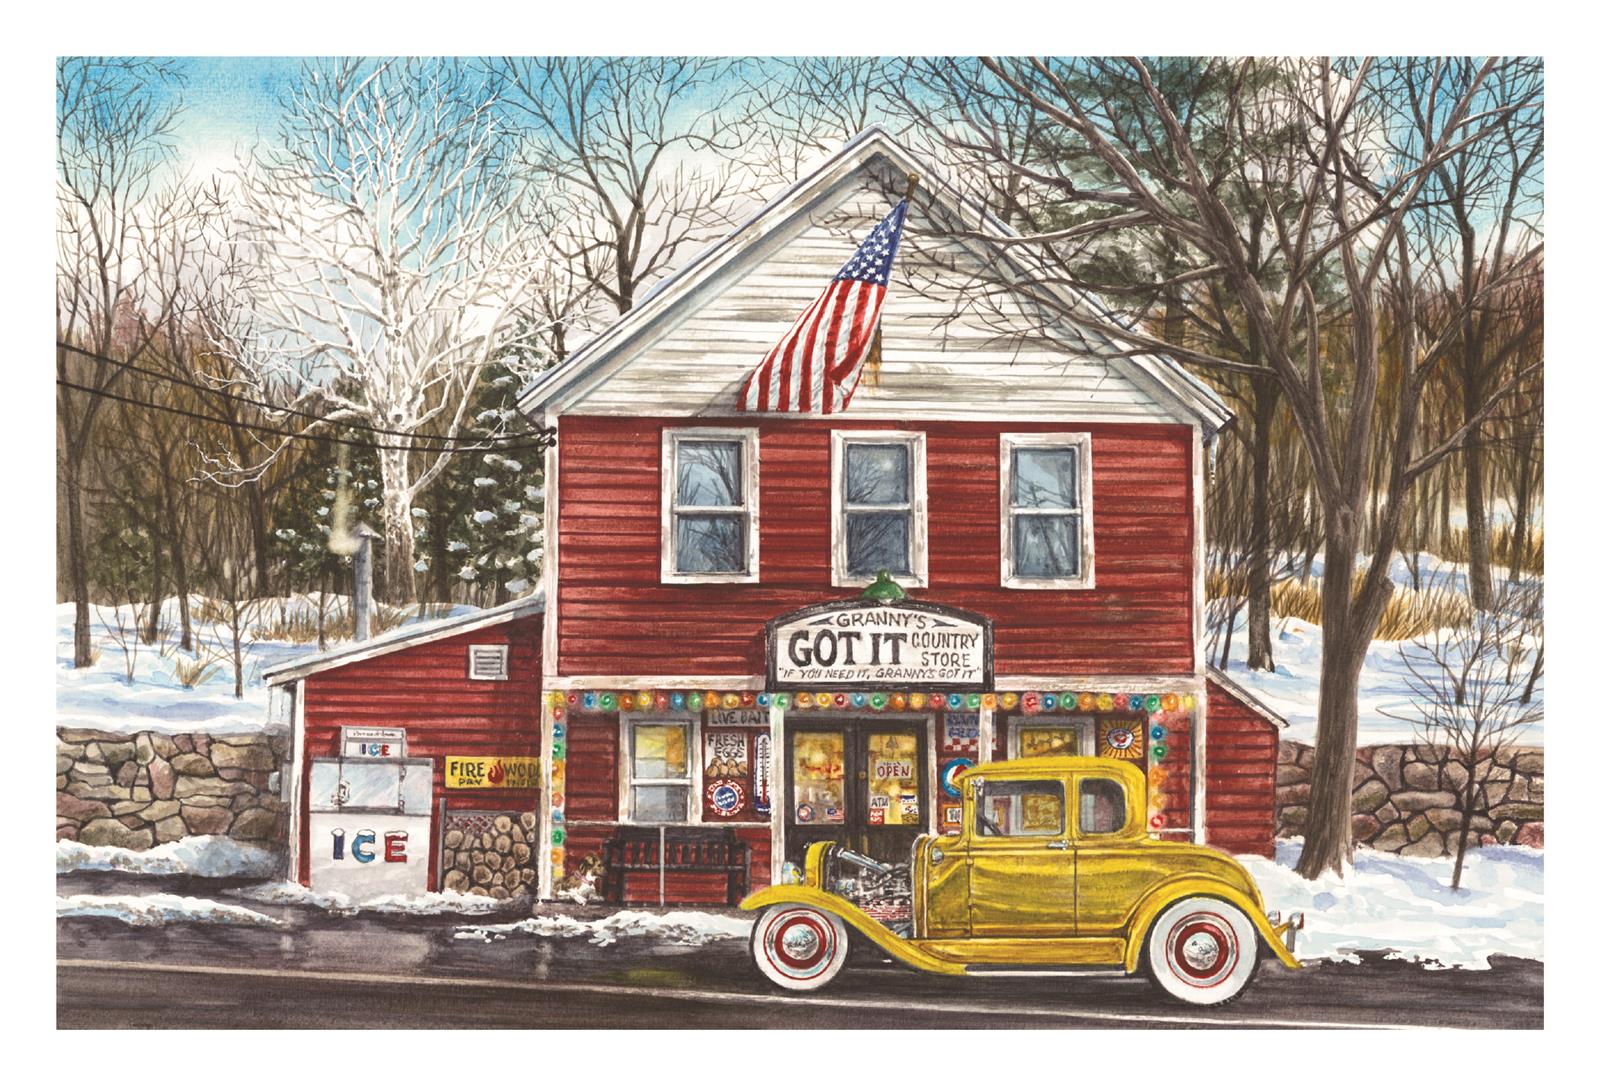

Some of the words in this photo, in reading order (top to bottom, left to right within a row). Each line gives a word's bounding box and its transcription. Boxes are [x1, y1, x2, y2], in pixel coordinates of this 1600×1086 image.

[836, 611, 927, 629] GRANNY'S
[911, 632, 979, 649] COUNTRY
[788, 629, 860, 667] GOT
[869, 632, 907, 665] IT
[921, 652, 970, 667] STORE
[799, 668, 822, 679] YOU
[825, 669, 855, 680] NEED
[875, 667, 936, 679] GRANNY'S
[938, 668, 961, 679] GOT
[712, 711, 737, 724] LIVE
[740, 711, 770, 724] BAIT
[707, 734, 745, 747] FRESH
[361, 743, 390, 757] ICE
[714, 746, 745, 758] EGGS
[450, 761, 485, 778] FIRE
[877, 765, 910, 778] OPEN
[871, 796, 889, 808] ATM
[331, 828, 409, 863] ICE
